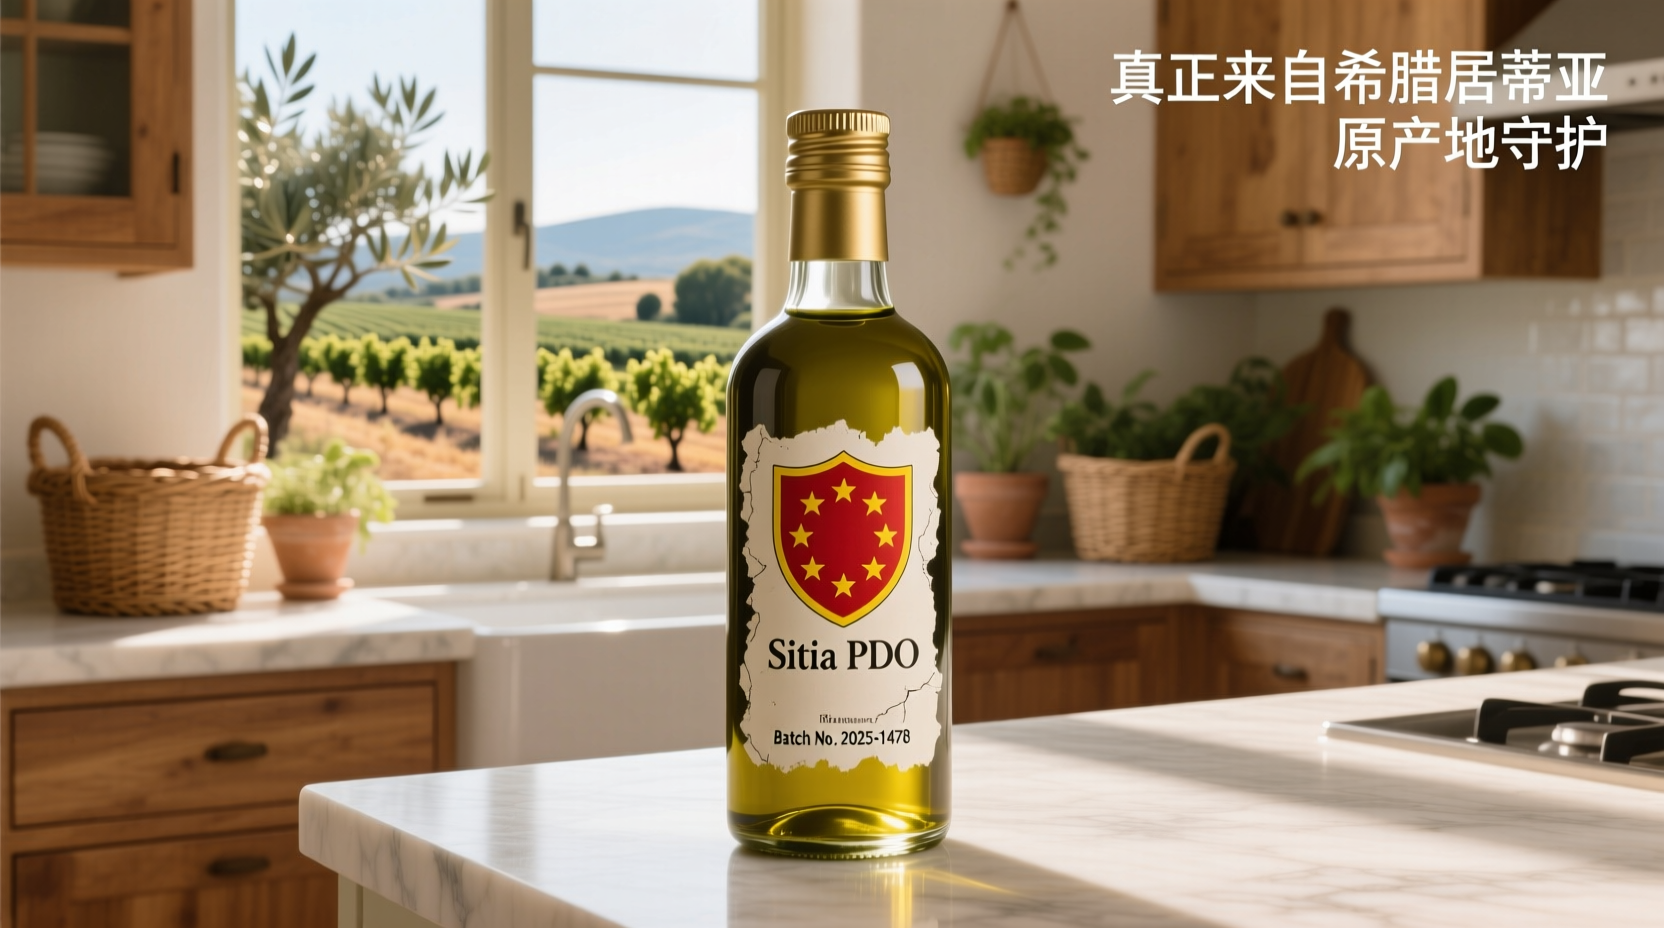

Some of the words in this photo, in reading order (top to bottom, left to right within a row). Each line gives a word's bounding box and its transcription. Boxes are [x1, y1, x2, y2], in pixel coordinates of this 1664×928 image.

[768, 638, 837, 671] Sitia
[847, 638, 919, 670] PDO
[774, 730, 811, 746] Batch
[815, 730, 837, 746] No.
[841, 729, 911, 746] 2025-1478
